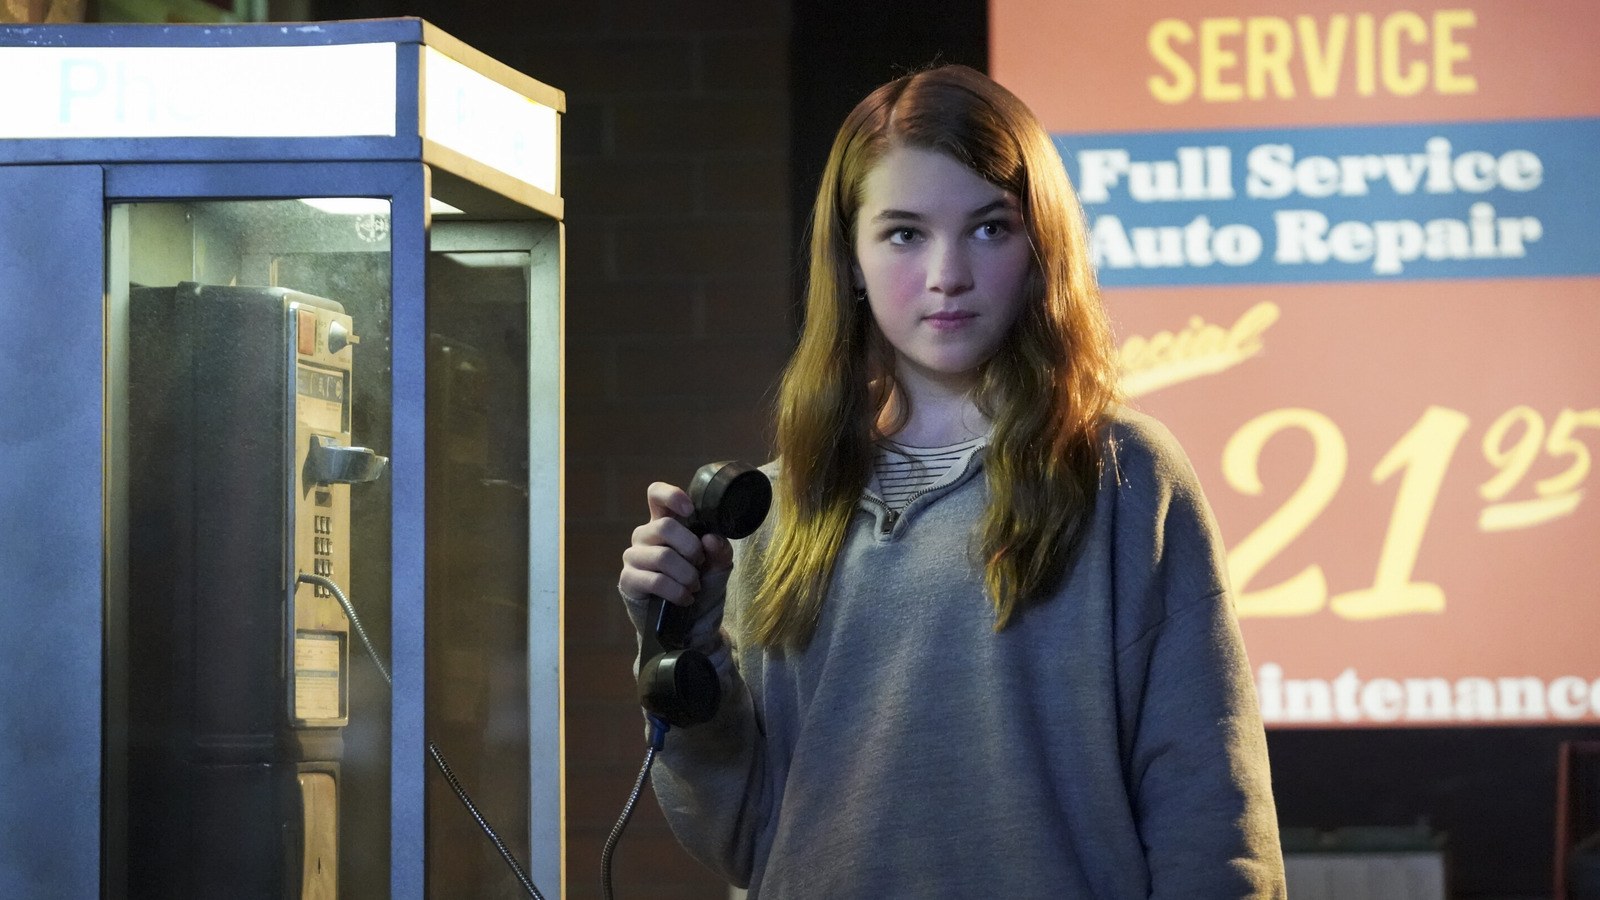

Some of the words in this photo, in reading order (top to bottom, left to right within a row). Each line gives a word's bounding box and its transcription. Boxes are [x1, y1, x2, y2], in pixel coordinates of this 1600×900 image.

[1147, 9, 1478, 104] SERVICE
[1077, 146, 1236, 204] Full
[1246, 136, 1544, 199] Service
[1090, 214, 1263, 269] Auto
[1273, 201, 1544, 275] Repair
[1118, 301, 1281, 372] ecial
[1258, 662, 1600, 723] intenanc
